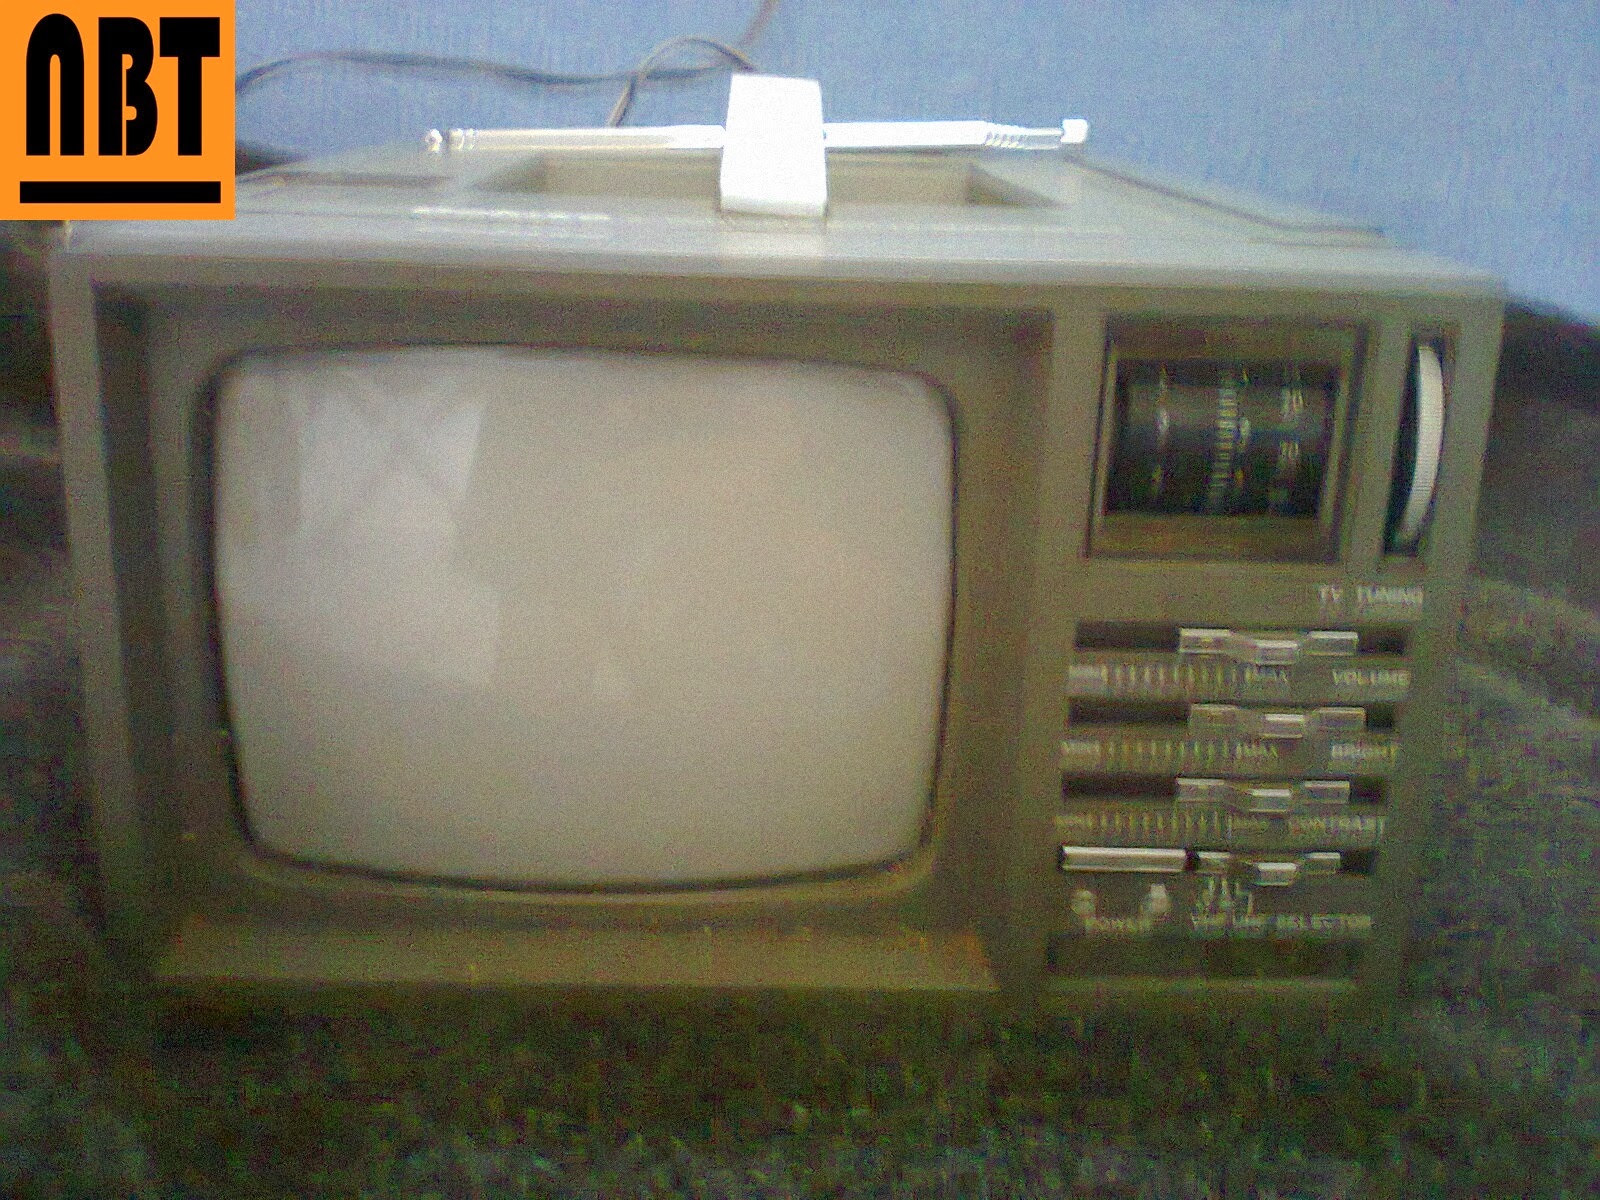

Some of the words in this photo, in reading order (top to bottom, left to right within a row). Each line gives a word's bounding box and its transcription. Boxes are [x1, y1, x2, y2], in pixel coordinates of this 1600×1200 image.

[1318, 585, 1344, 603] TV
[1356, 585, 1423, 604] TUNING
[1331, 669, 1411, 686] VOLUME
[1274, 913, 1372, 931] SELECTOR
